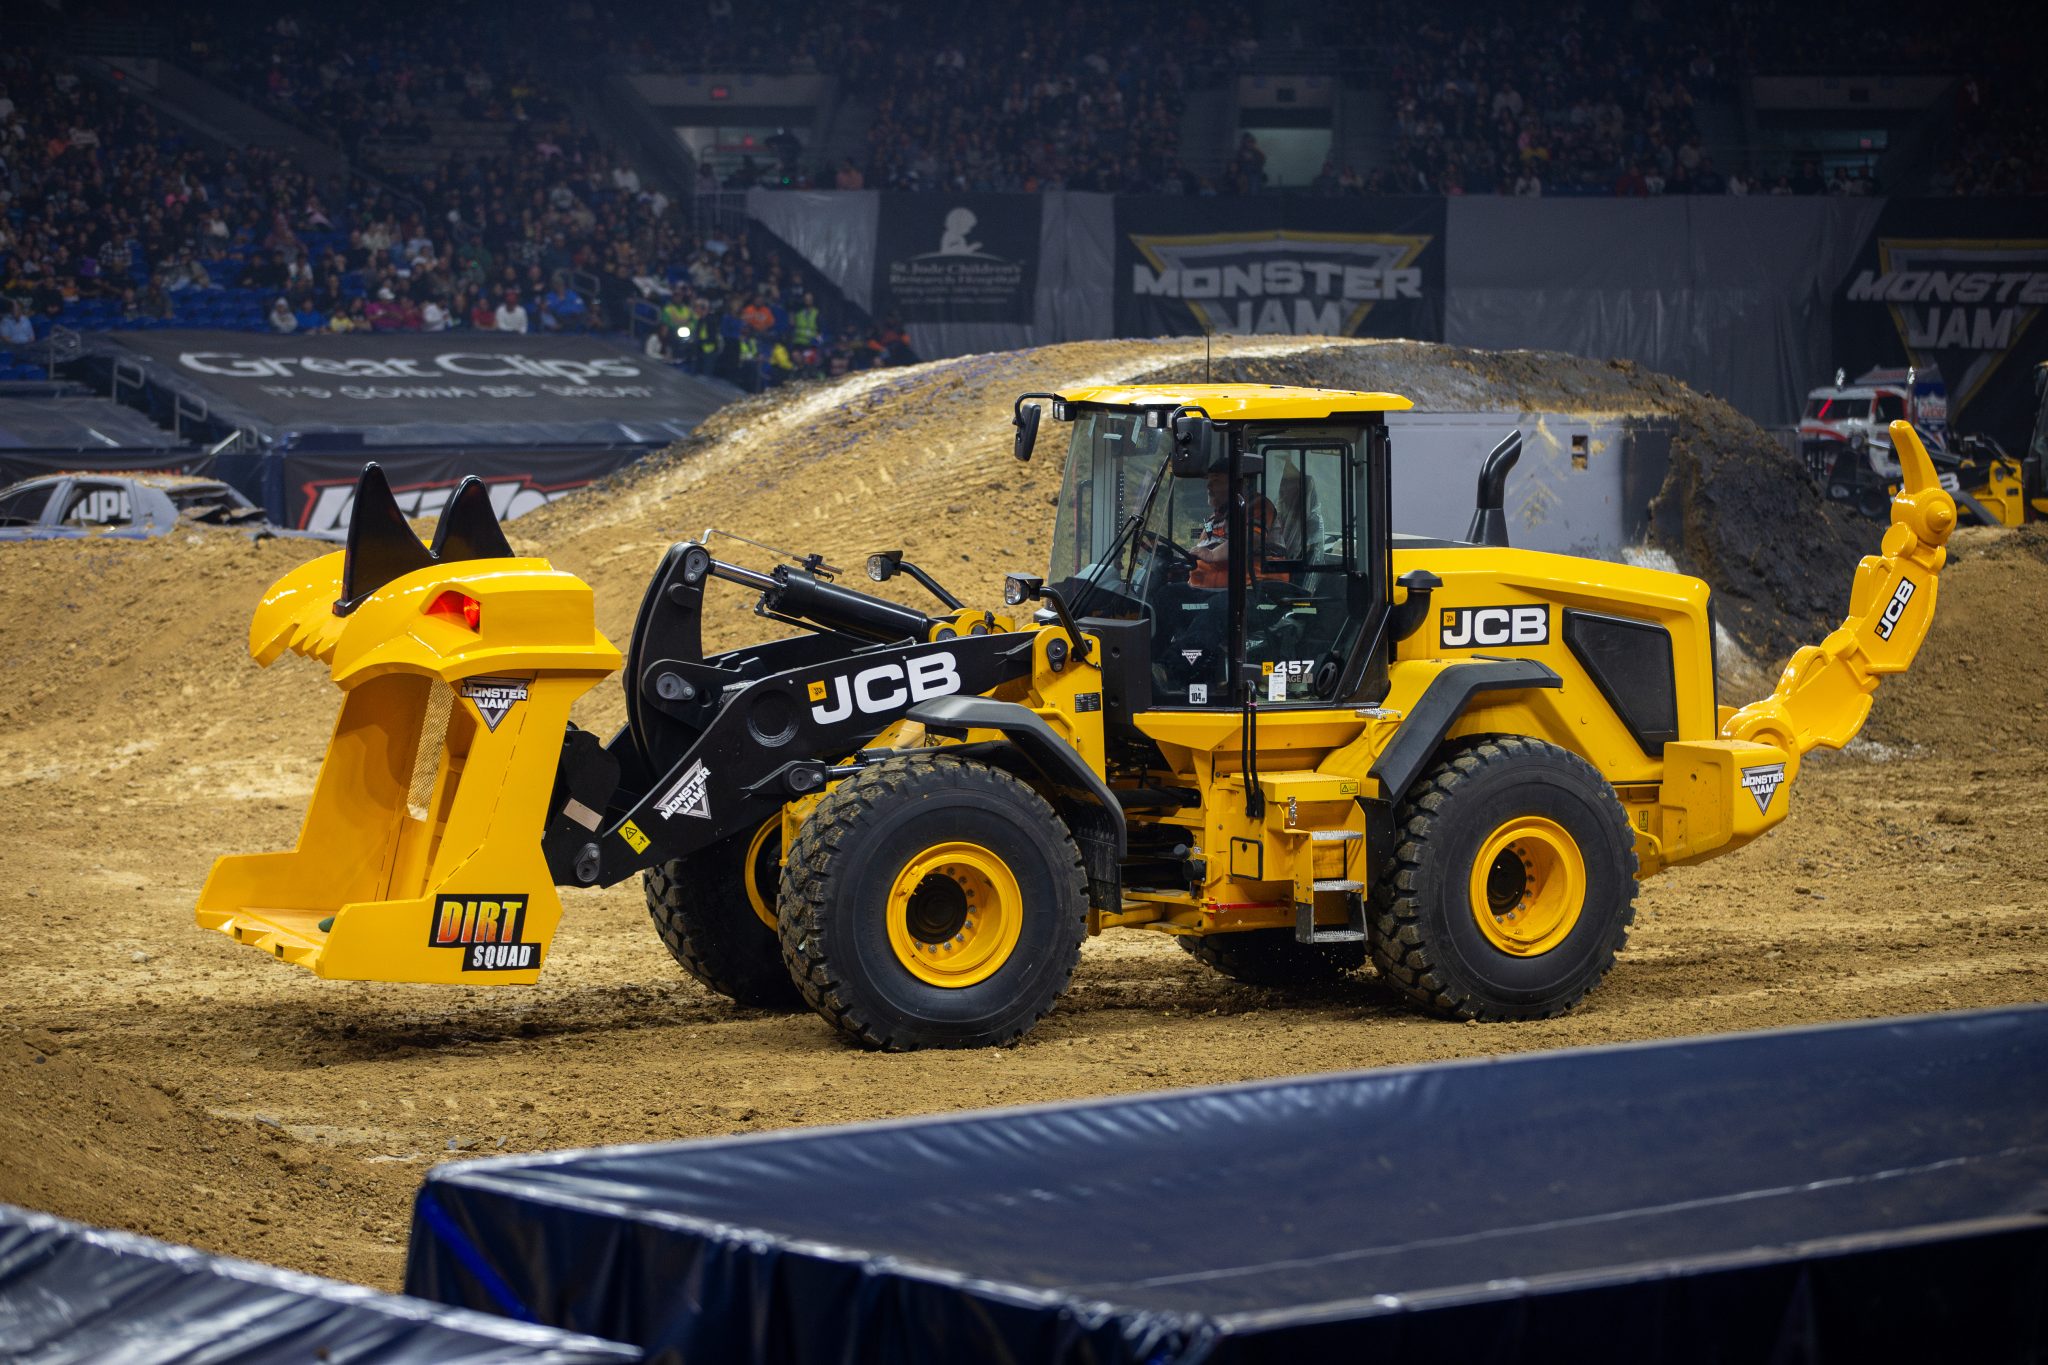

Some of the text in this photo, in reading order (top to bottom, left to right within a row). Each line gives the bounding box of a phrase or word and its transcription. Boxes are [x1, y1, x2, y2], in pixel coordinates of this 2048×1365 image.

[1133, 260, 1423, 298] MONSTER
[1212, 298, 1341, 336] JAM
[1907, 307, 2014, 349] JAM
[179, 352, 640, 386] Great Clips
[1442, 607, 1547, 646] JCB
[1880, 579, 1914, 639] JCB
[1274, 660, 1315, 675] 457
[461, 686, 528, 700] MONSTER
[480, 698, 510, 709] JAM
[812, 651, 961, 725] JCB
[660, 766, 712, 820] MONSTER
[1742, 772, 1784, 787] MONSTER
[1753, 783, 1774, 795] JAM
[683, 786, 706, 814] JAM
[436, 900, 523, 943] DIRT
[472, 945, 532, 969] SQUAD
